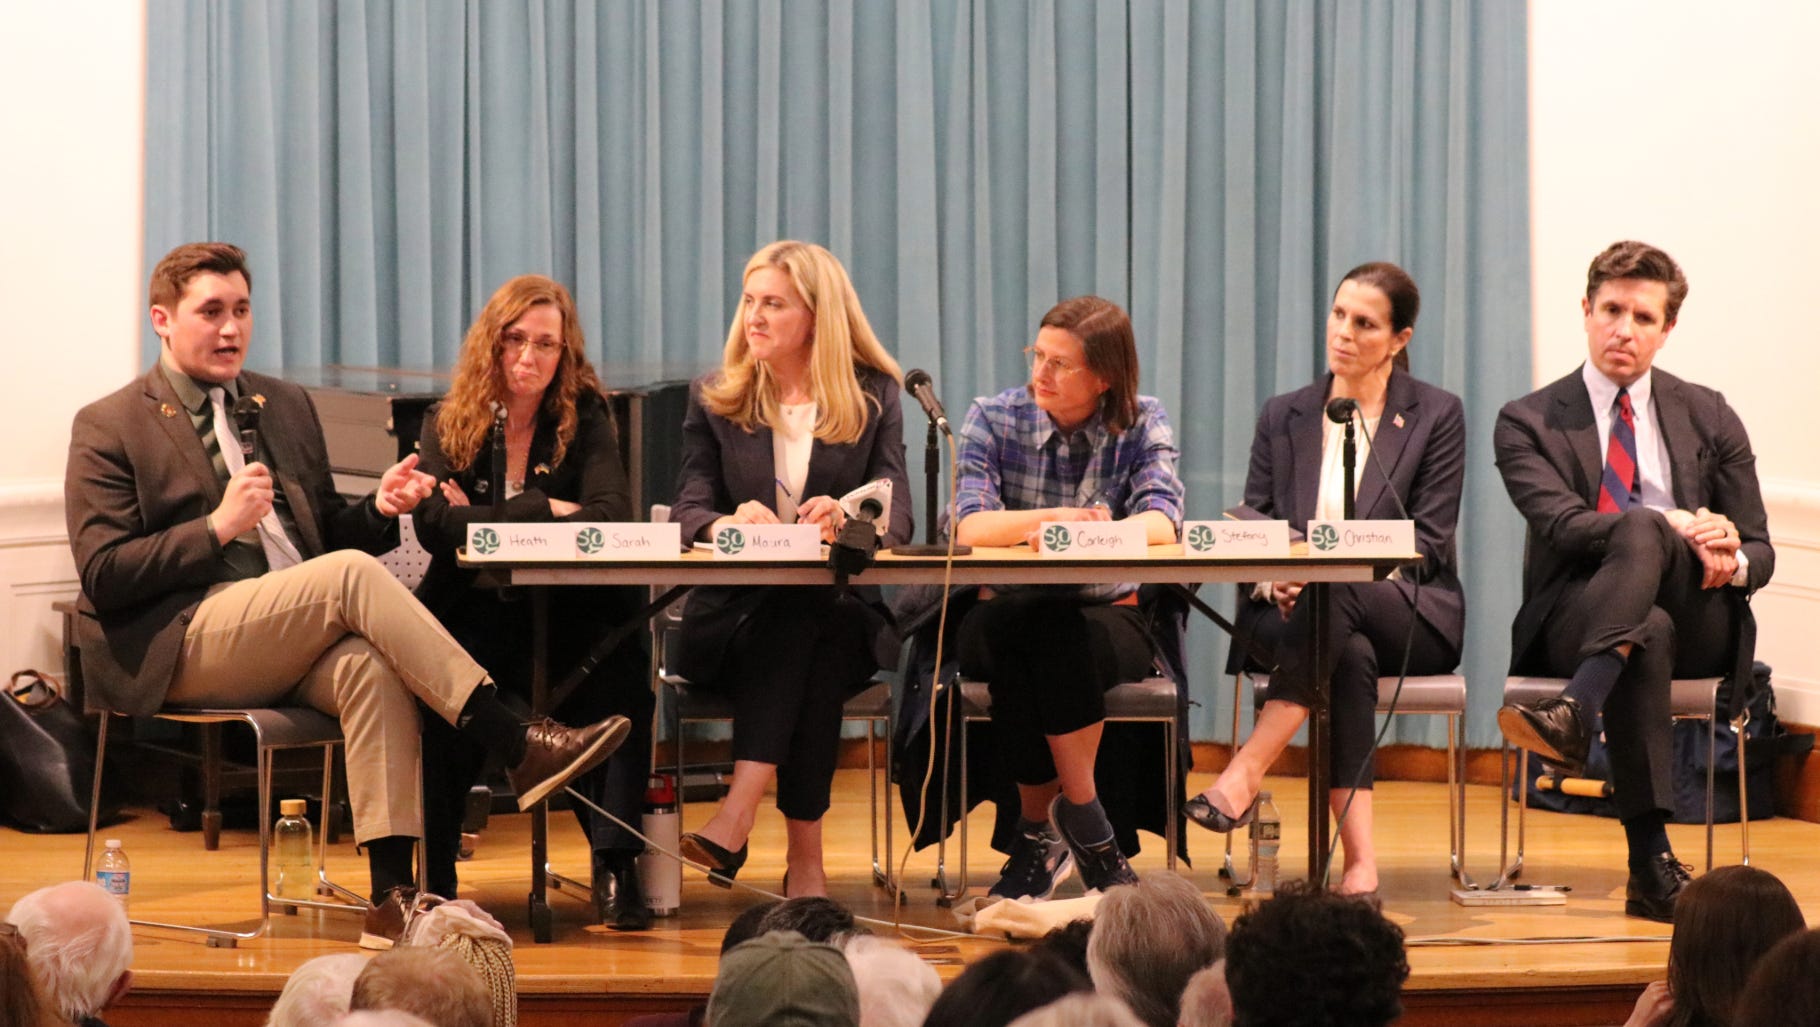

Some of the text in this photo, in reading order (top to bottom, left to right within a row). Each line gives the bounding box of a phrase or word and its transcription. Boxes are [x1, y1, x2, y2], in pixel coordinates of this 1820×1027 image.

[509, 533, 548, 547] Heath
[611, 532, 651, 549] Sarah
[1344, 529, 1393, 547] Christian
